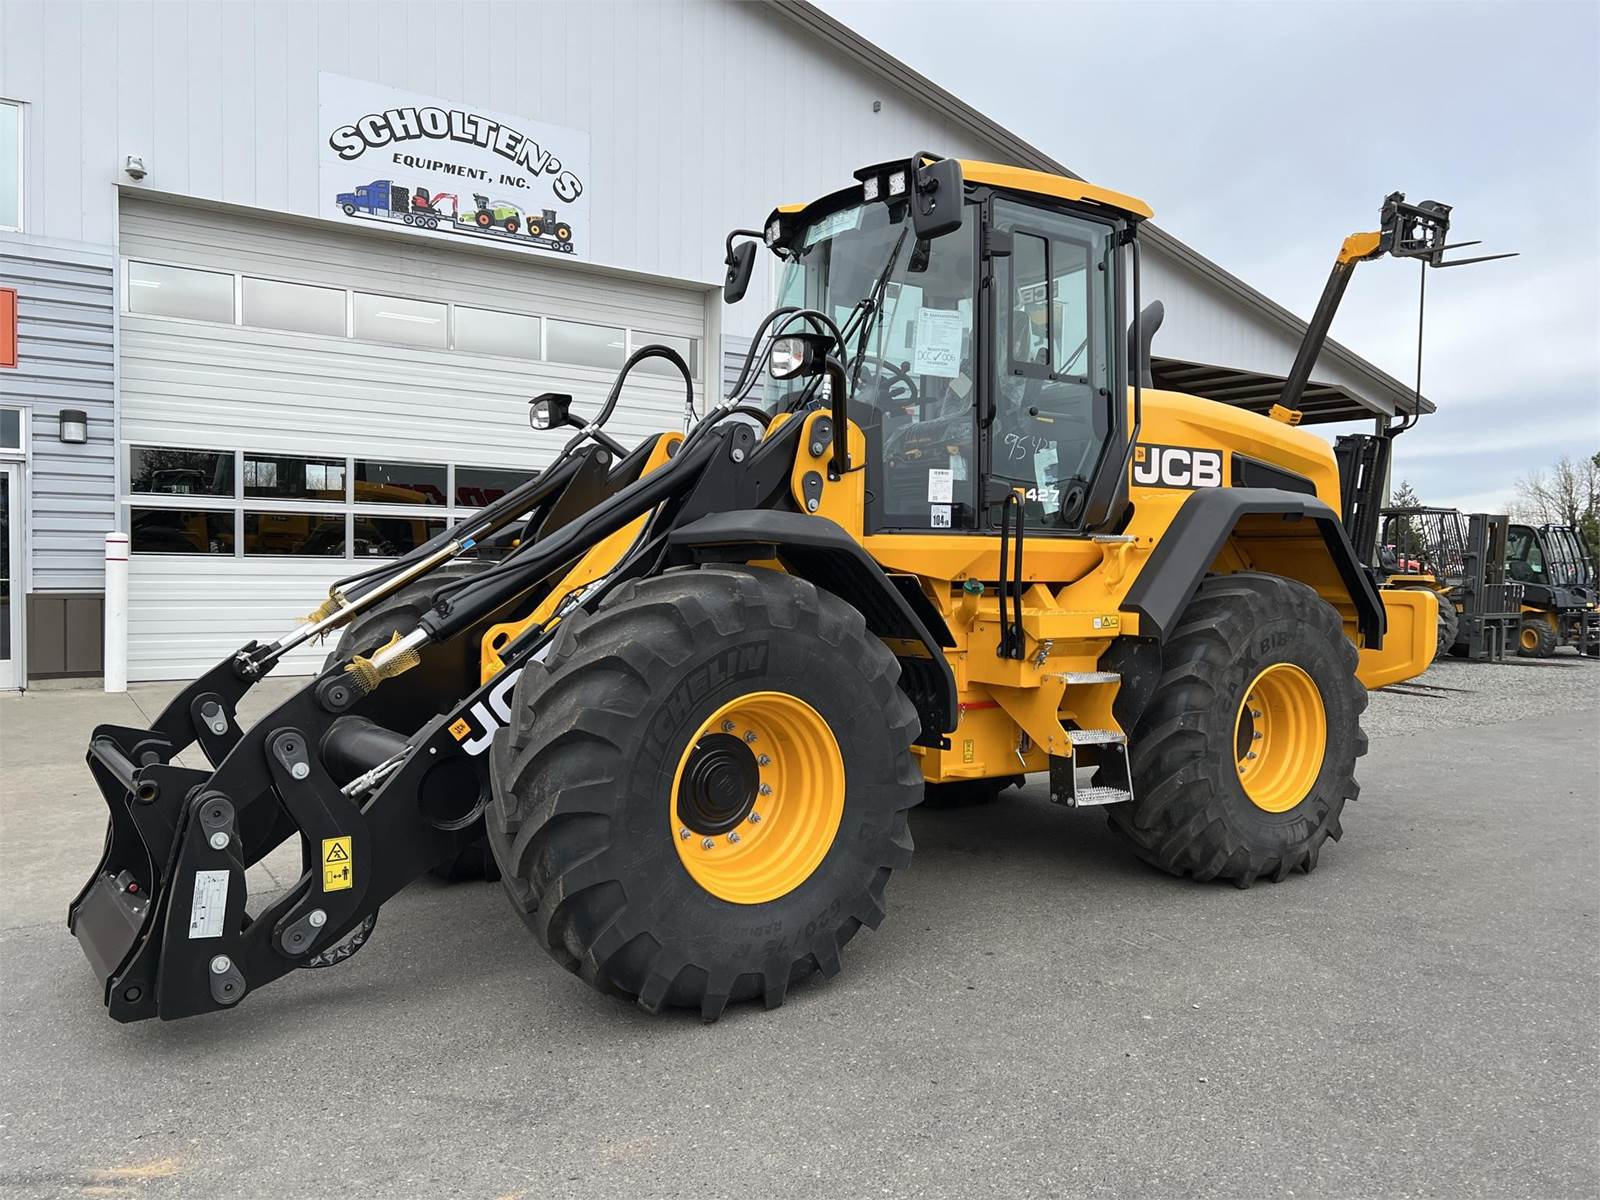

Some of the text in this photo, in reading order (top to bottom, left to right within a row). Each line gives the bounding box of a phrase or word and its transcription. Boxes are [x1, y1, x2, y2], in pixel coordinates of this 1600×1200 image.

[329, 106, 583, 203] SCHOLTEN'S
[392, 152, 531, 190] EQUIPMENT, INC.
[1134, 447, 1221, 487] JCB
[1026, 487, 1059, 502] 427
